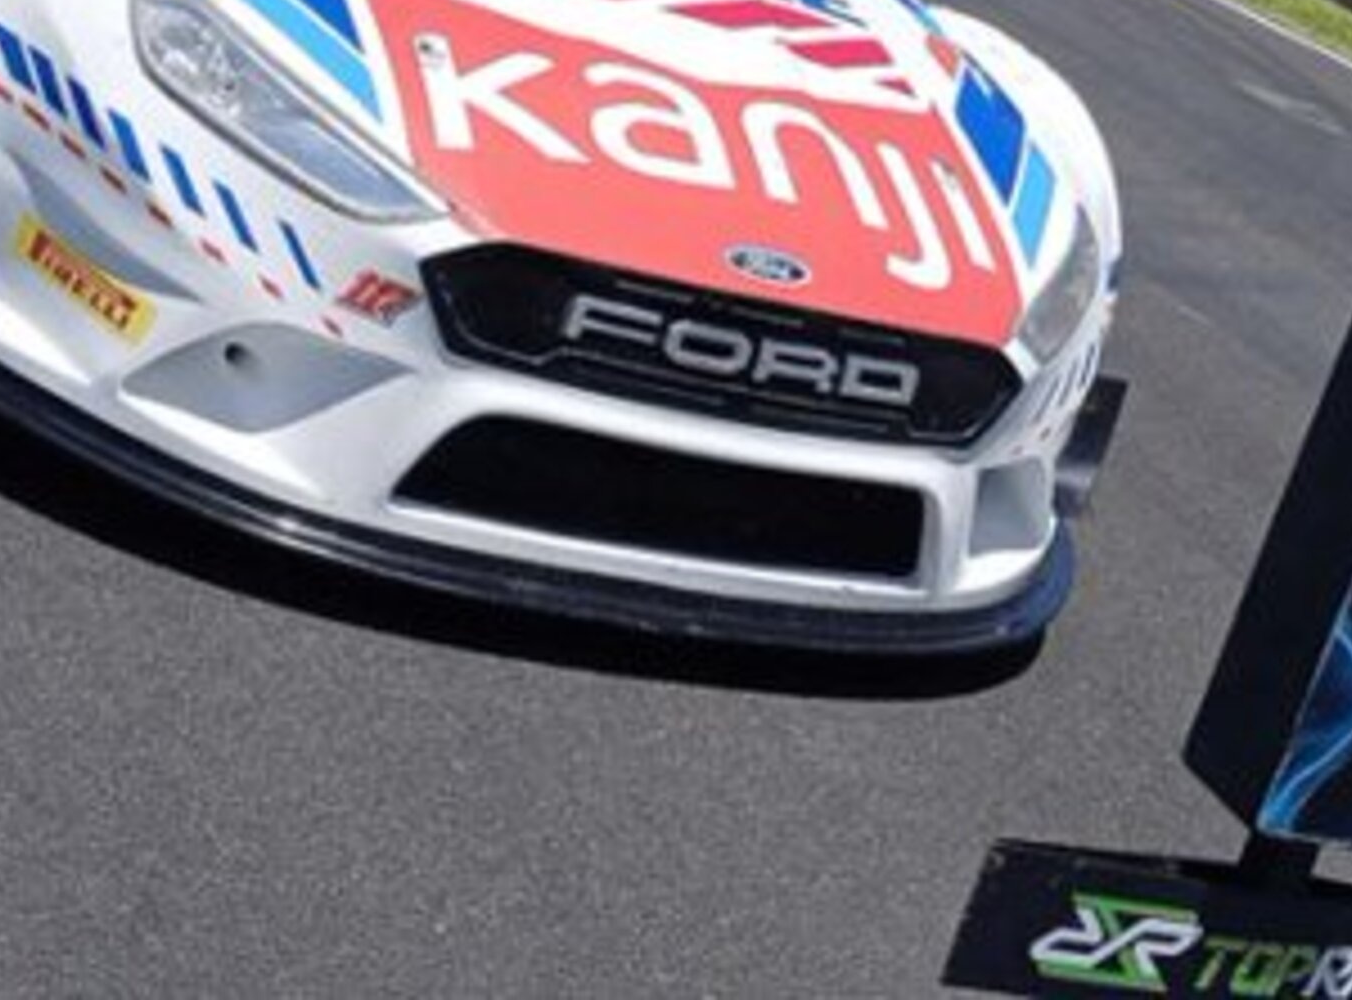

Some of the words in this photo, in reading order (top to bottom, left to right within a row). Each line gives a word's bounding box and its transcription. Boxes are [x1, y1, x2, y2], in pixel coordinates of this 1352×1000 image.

[412, 34, 996, 291] kanji
[28, 228, 137, 331] PIRELLI
[565, 294, 920, 404] FORD
